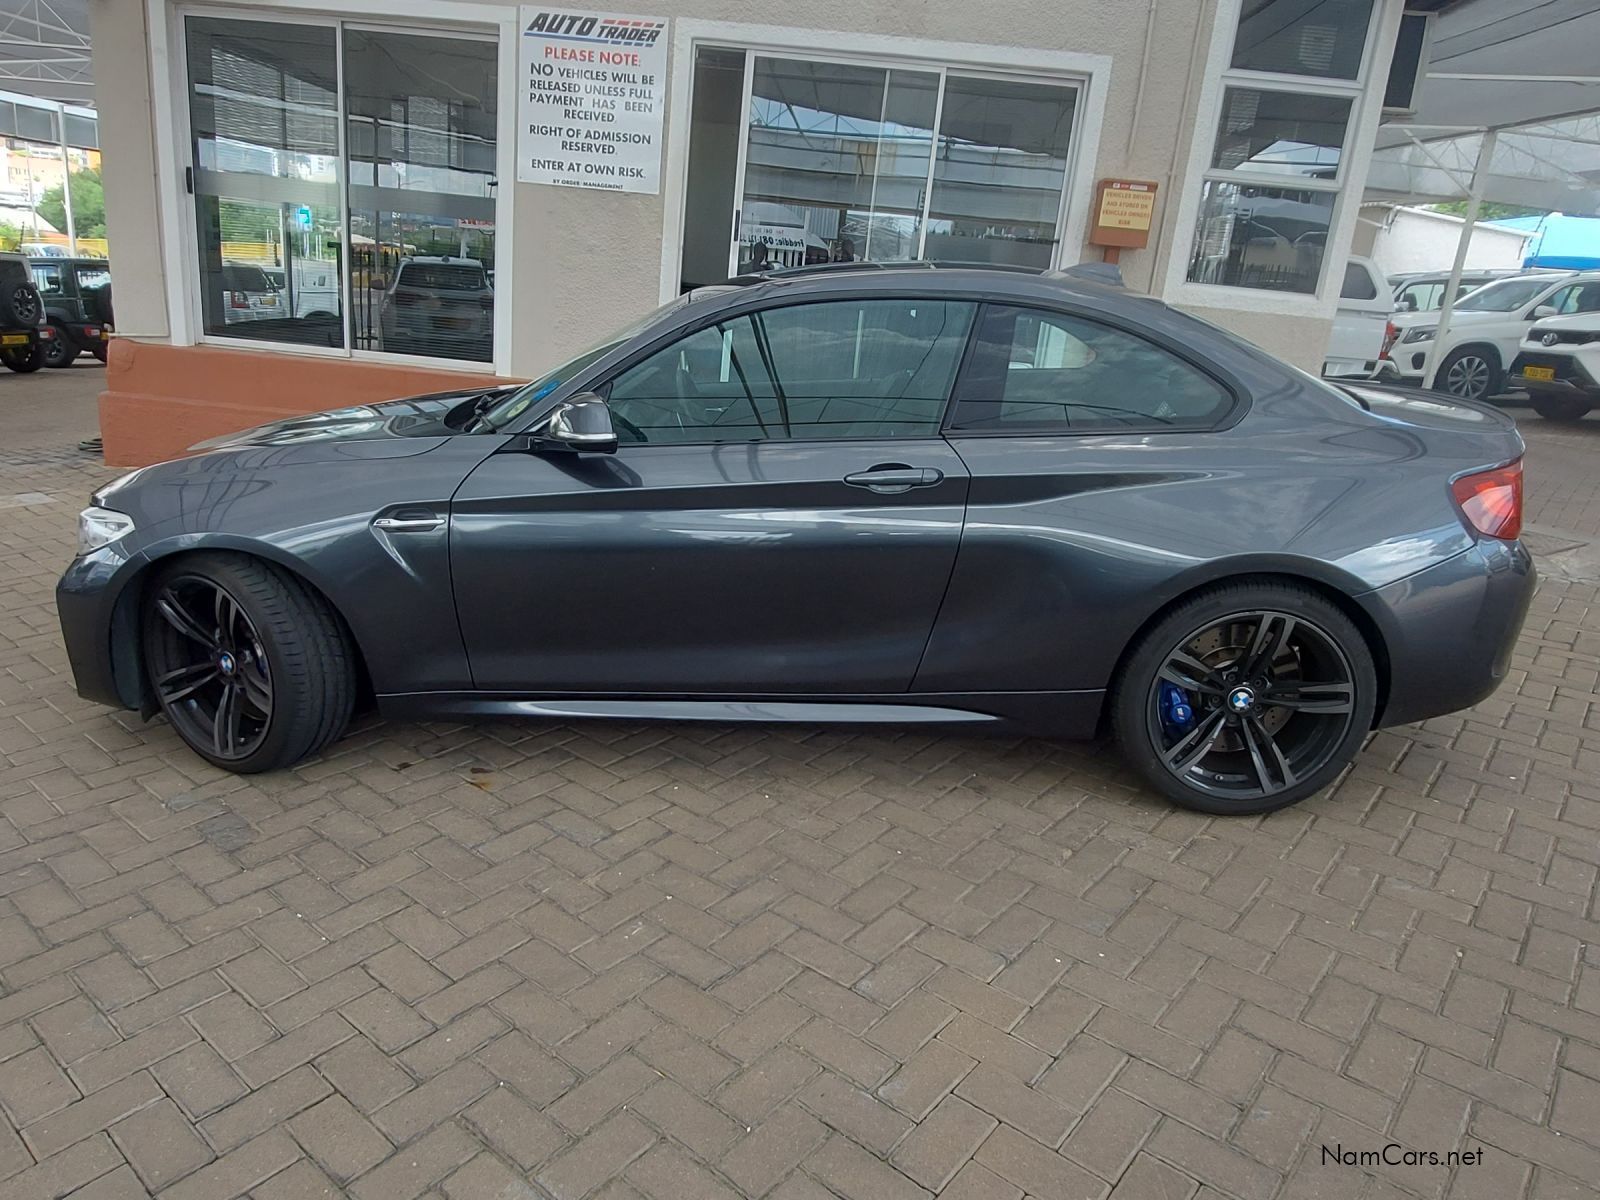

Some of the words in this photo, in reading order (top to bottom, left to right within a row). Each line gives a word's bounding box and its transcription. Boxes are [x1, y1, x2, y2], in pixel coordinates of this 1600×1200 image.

[527, 13, 598, 35] AUTO
[597, 26, 660, 42] TRADER
[545, 47, 594, 62] PLEASE
[531, 63, 553, 76] NO
[558, 67, 607, 82] VEHICLES
[612, 73, 637, 84] WILL
[642, 75, 654, 85] BE
[530, 80, 580, 92] RELEASED
[585, 85, 625, 97] UNLESS
[630, 89, 653, 99] FULL
[530, 93, 584, 107] PAYMENT
[592, 98, 615, 109] HAS
[625, 102, 652, 112] BEEN
[530, 125, 563, 137] RIGHT
[566, 128, 581, 138] OF
[585, 130, 651, 144] ADMISSION
[562, 141, 618, 155] RESERVED.
[532, 159, 564, 171] ENTER
[568, 163, 581, 173] AT
[585, 165, 614, 175] OWN
[619, 167, 646, 179] RISK.
[583, 181, 623, 189] MANAGEMENT
